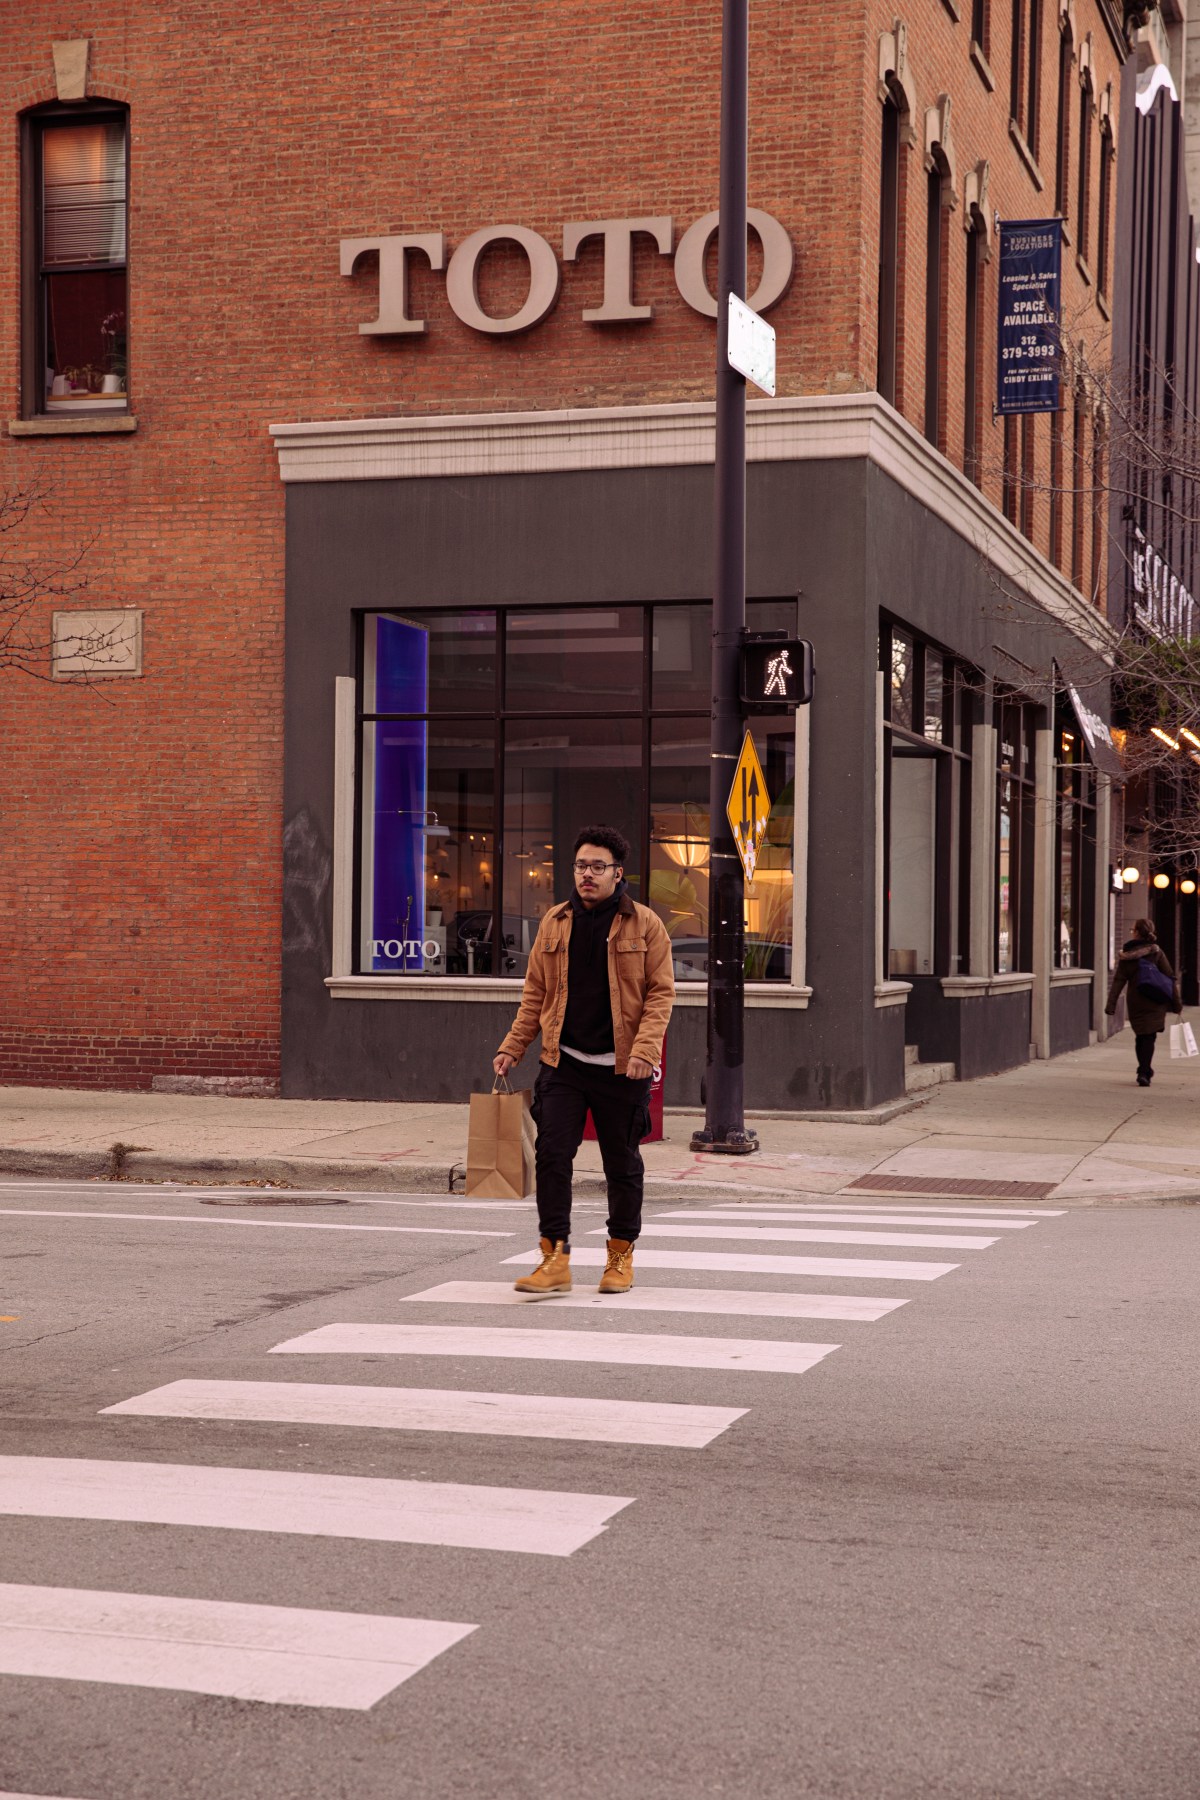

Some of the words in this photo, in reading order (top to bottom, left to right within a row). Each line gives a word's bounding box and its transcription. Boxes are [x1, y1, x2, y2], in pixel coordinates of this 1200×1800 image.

[1010, 234, 1053, 244] BUSINESS
[1010, 242, 1053, 251] LOCATIONS
[340, 207, 794, 335] TOTO
[1002, 274, 1029, 283] Leasing
[1038, 272, 1057, 280] Sales
[1012, 281, 1047, 291] Specialist
[1013, 300, 1045, 313] SPACE
[1003, 313, 1054, 326] AVAILABLE
[1021, 336, 1037, 345] 312
[1002, 345, 1055, 359] 379-3993
[1003, 375, 1026, 384] CINDY
[1028, 373, 1053, 382] EXLINE
[79, 636, 114, 651] 1884
[367, 939, 441, 959] TOTO
